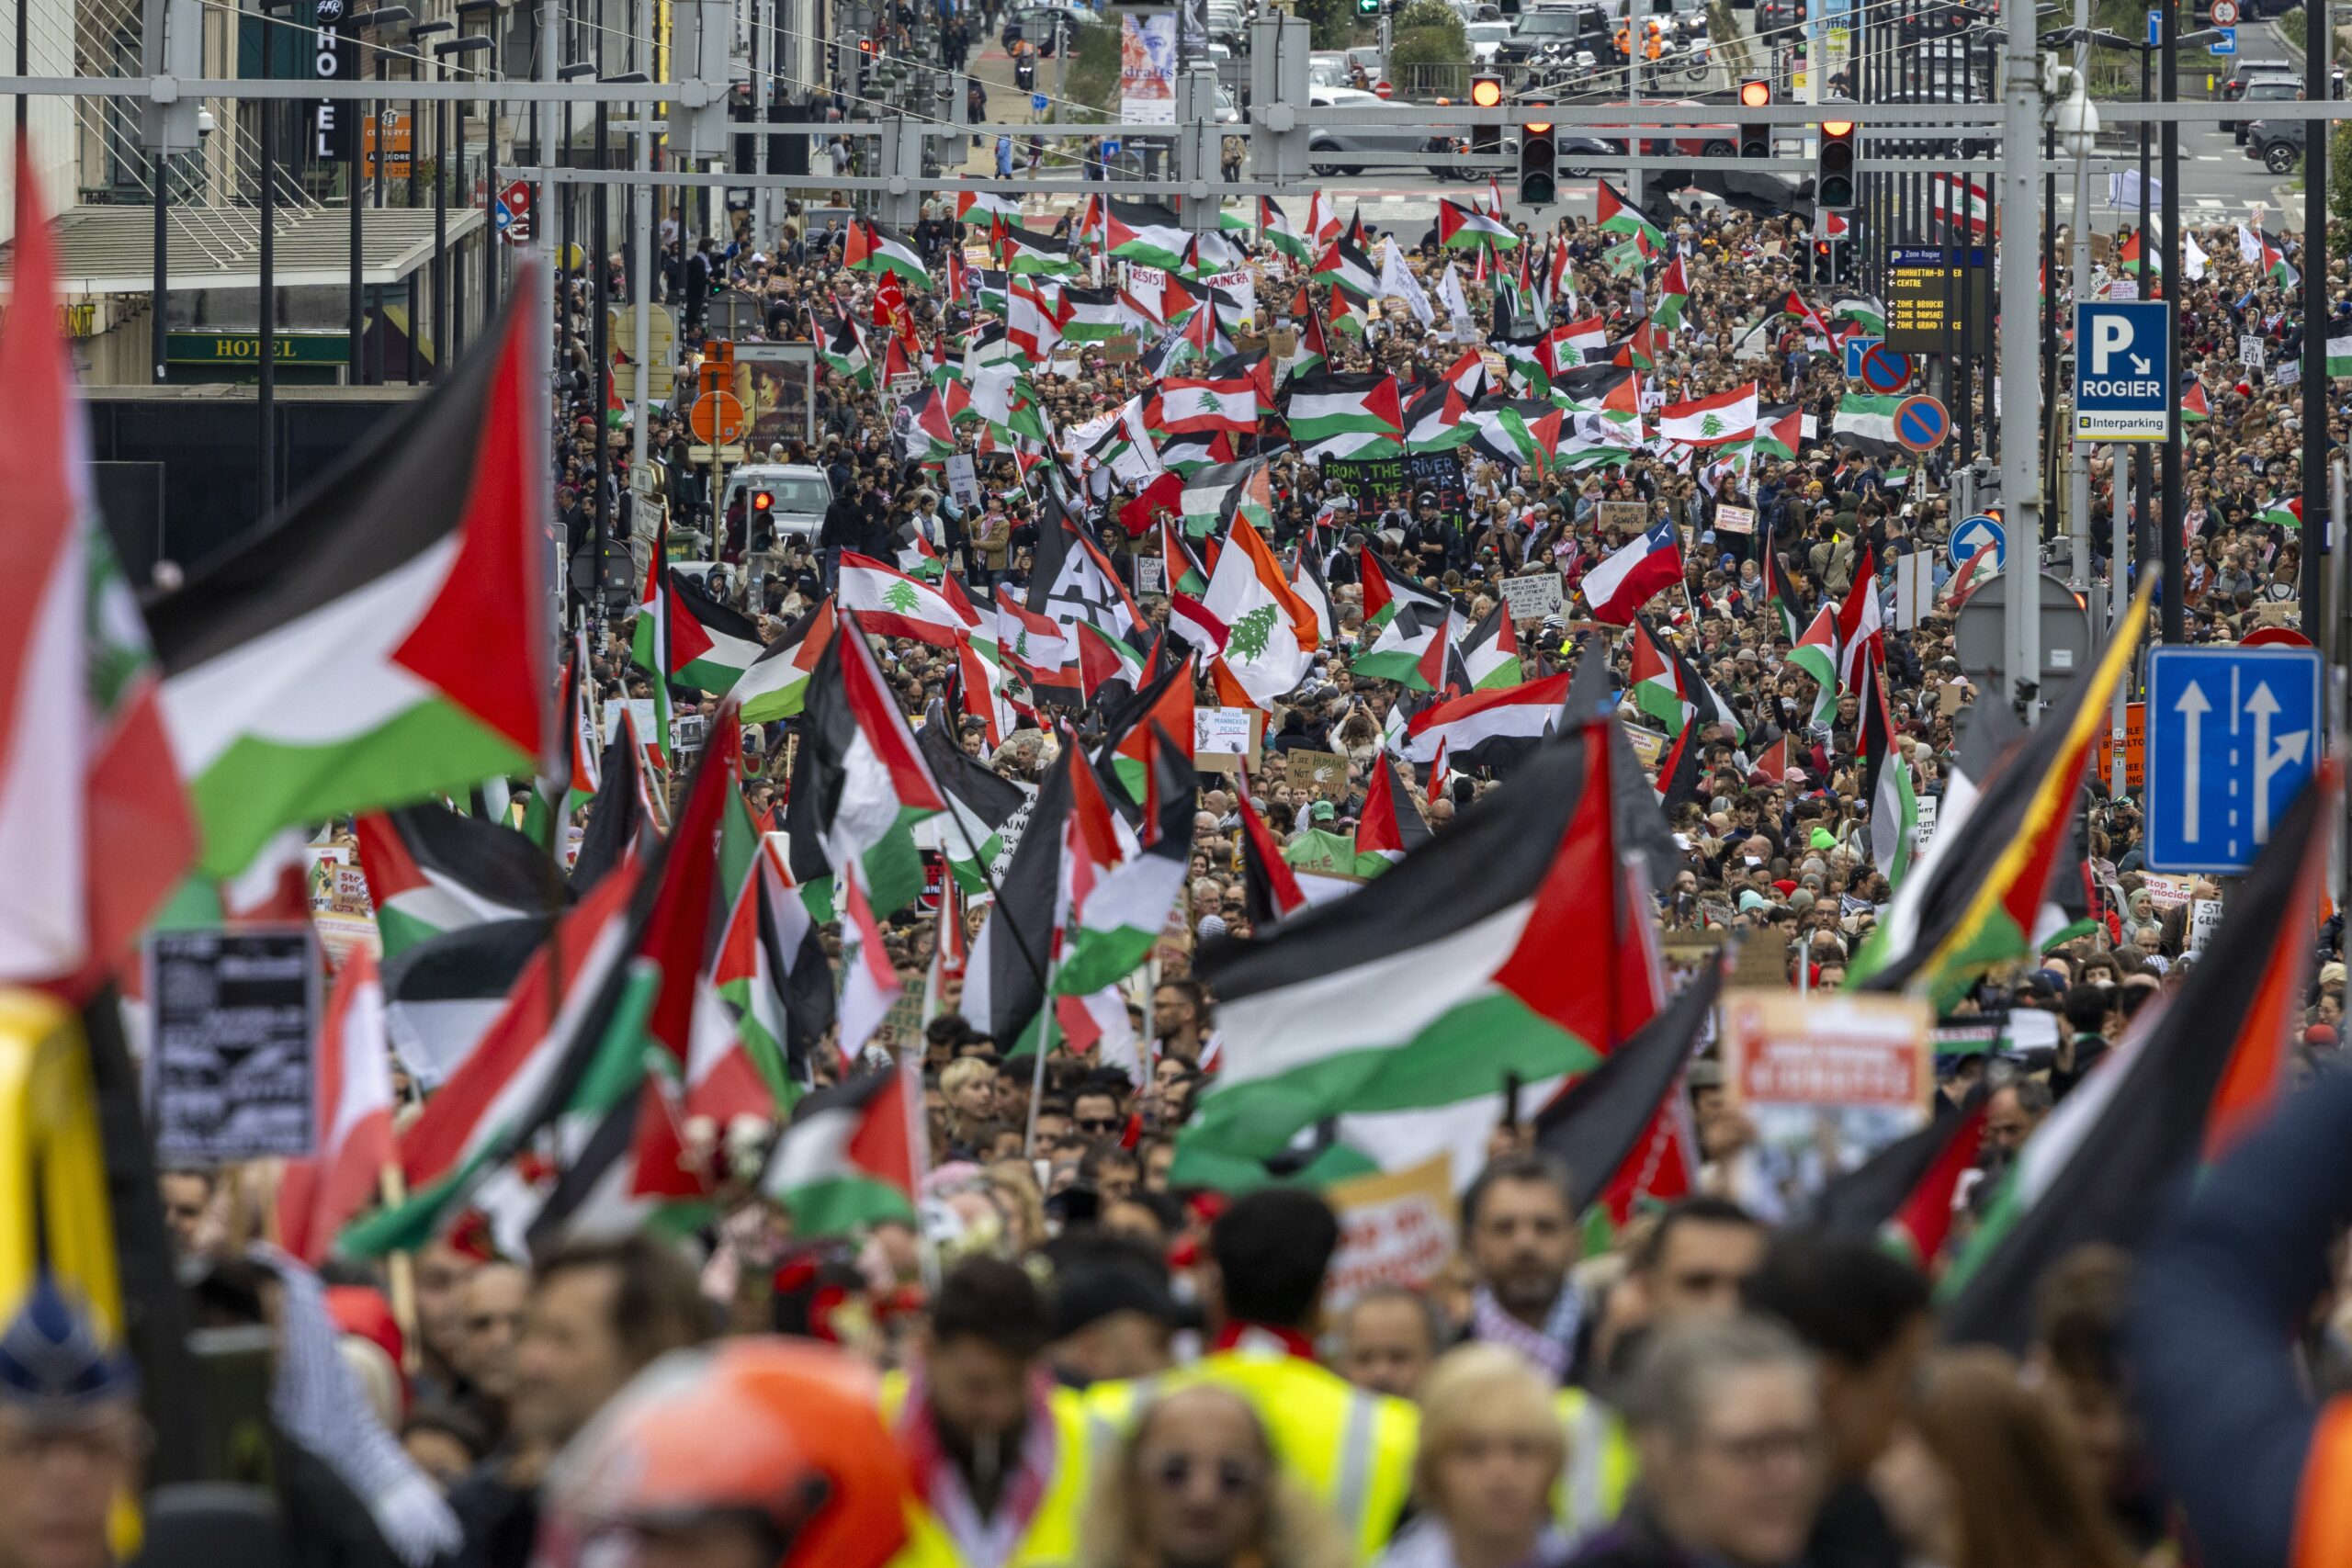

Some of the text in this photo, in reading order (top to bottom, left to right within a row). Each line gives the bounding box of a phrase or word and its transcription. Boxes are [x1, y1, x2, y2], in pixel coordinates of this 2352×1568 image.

[316, 26, 337, 156] HOEL
[367, 129, 403, 137] CETURY
[1922, 251, 1940, 259] Rogier
[2243, 336, 2262, 345] SHAME
[2245, 352, 2258, 363] EU
[2083, 380, 2161, 397] ROGIER
[2093, 418, 2164, 430] Interparking
[1326, 457, 1455, 479] FROM THE RIVER
[1721, 513, 1749, 522] genocide
[1289, 753, 1297, 764] I
[1313, 754, 1348, 770] HUMANS
[1295, 768, 1309, 778] NOT
